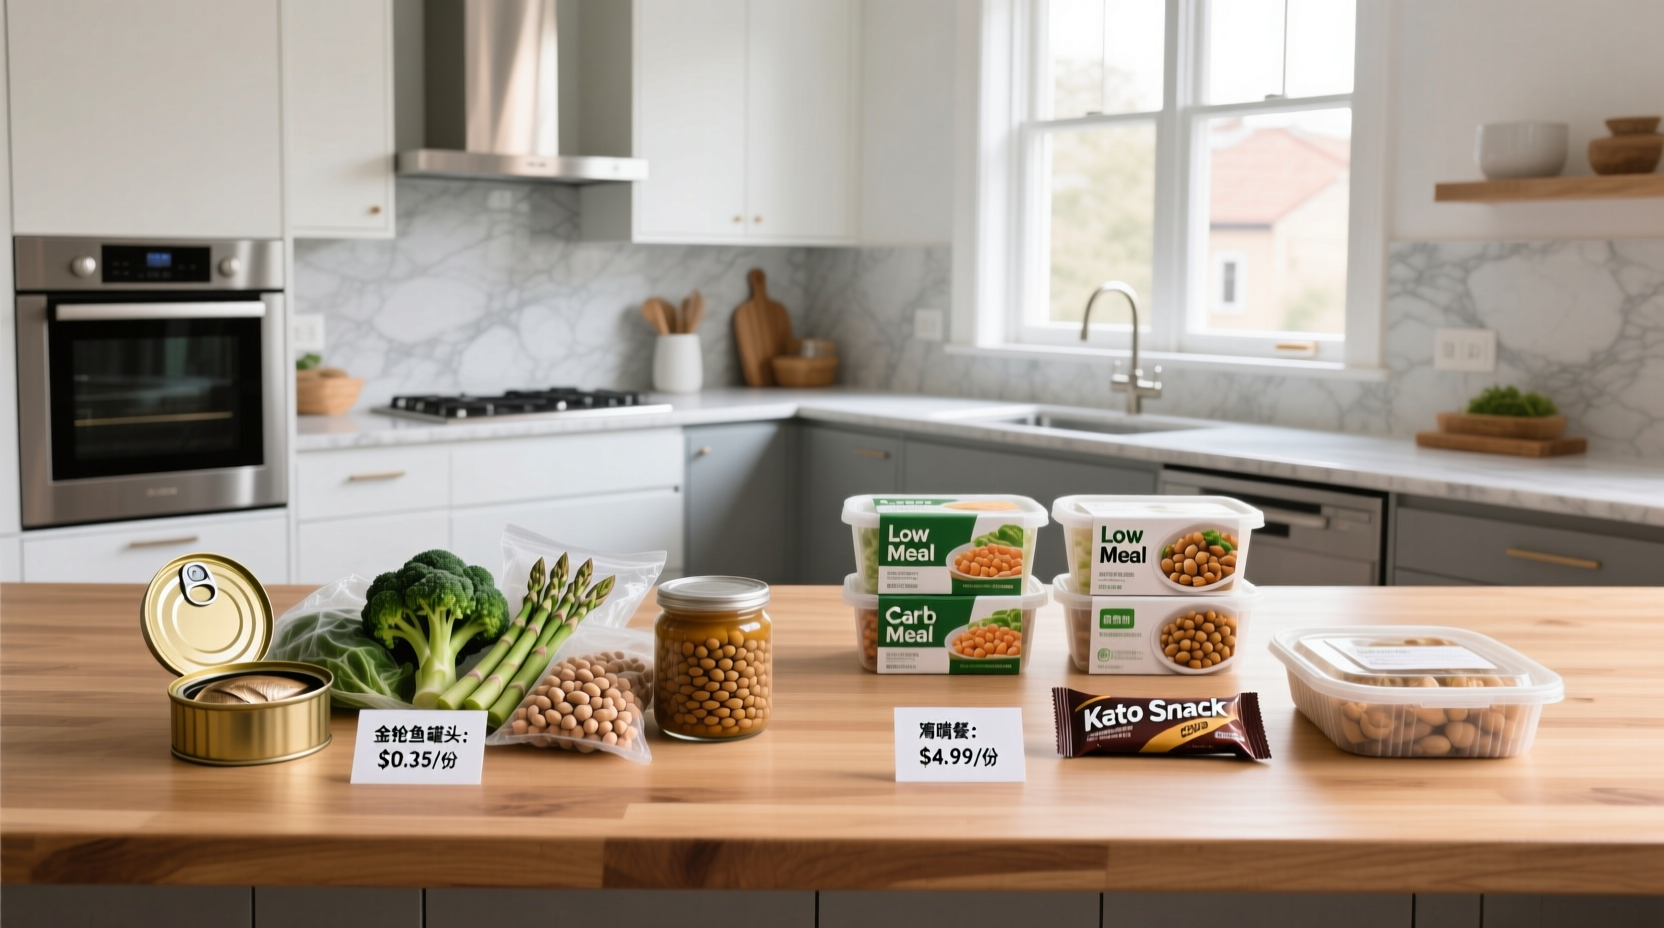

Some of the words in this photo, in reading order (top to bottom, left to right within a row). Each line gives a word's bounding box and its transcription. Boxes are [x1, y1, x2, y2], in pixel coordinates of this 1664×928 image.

[888, 524, 930, 543] Low
[1101, 525, 1144, 544] Low
[887, 543, 935, 562] Meal
[1099, 546, 1147, 564] Meal
[885, 605, 937, 625] Carb
[885, 626, 934, 643] Meal
[1084, 703, 1144, 732] Kato
[1148, 698, 1229, 723] Snack
[377, 748, 458, 770] $0.35/份
[919, 746, 999, 769] $4.99/份
